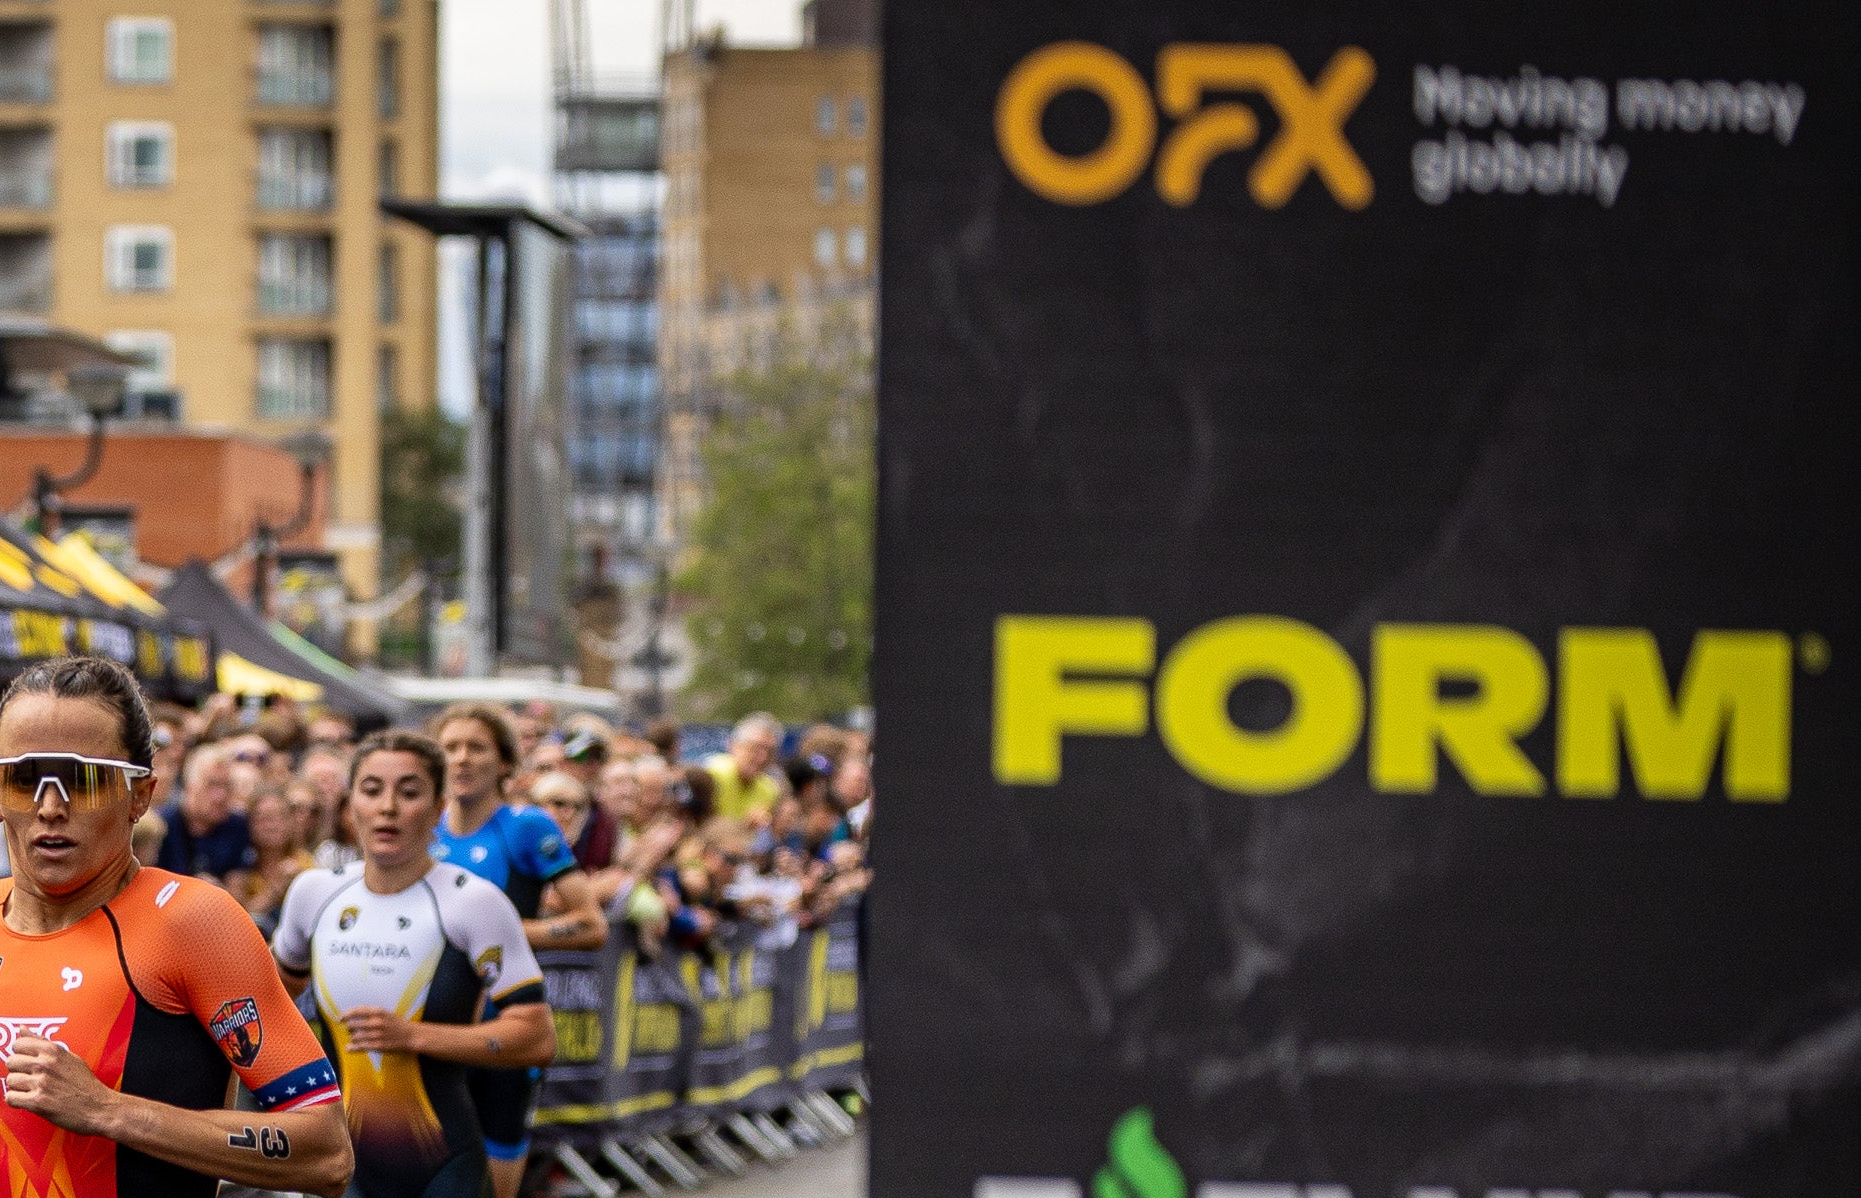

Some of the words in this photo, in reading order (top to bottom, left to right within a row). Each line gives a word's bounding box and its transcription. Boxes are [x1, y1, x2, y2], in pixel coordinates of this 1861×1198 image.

[995, 42, 1376, 207] OFX
[1413, 64, 1609, 138] Moving
[1616, 79, 1805, 147] money
[1411, 130, 1629, 208] globally
[992, 614, 1793, 800] FORM
[212, 1000, 259, 1042] WARRIORS
